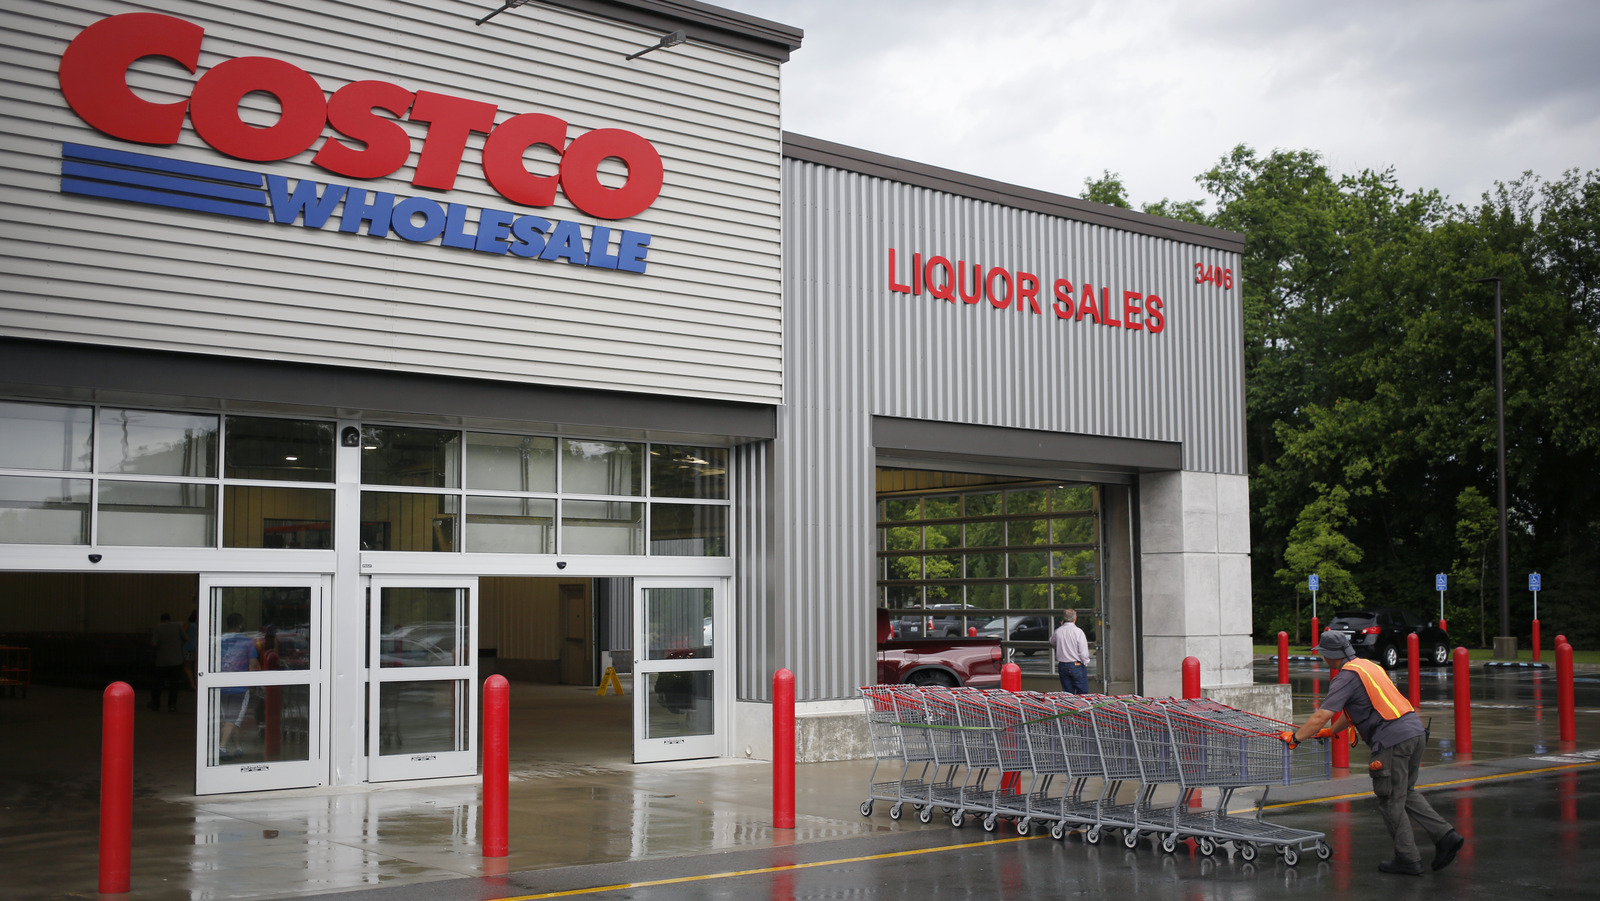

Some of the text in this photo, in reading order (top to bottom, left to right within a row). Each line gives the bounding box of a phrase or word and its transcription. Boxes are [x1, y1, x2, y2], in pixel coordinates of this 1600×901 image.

[59, 13, 664, 220] COSTCO
[265, 174, 652, 274] WHOLESALE
[888, 248, 1166, 334] LIQUOR SALES
[1195, 262, 1234, 290] 3406
